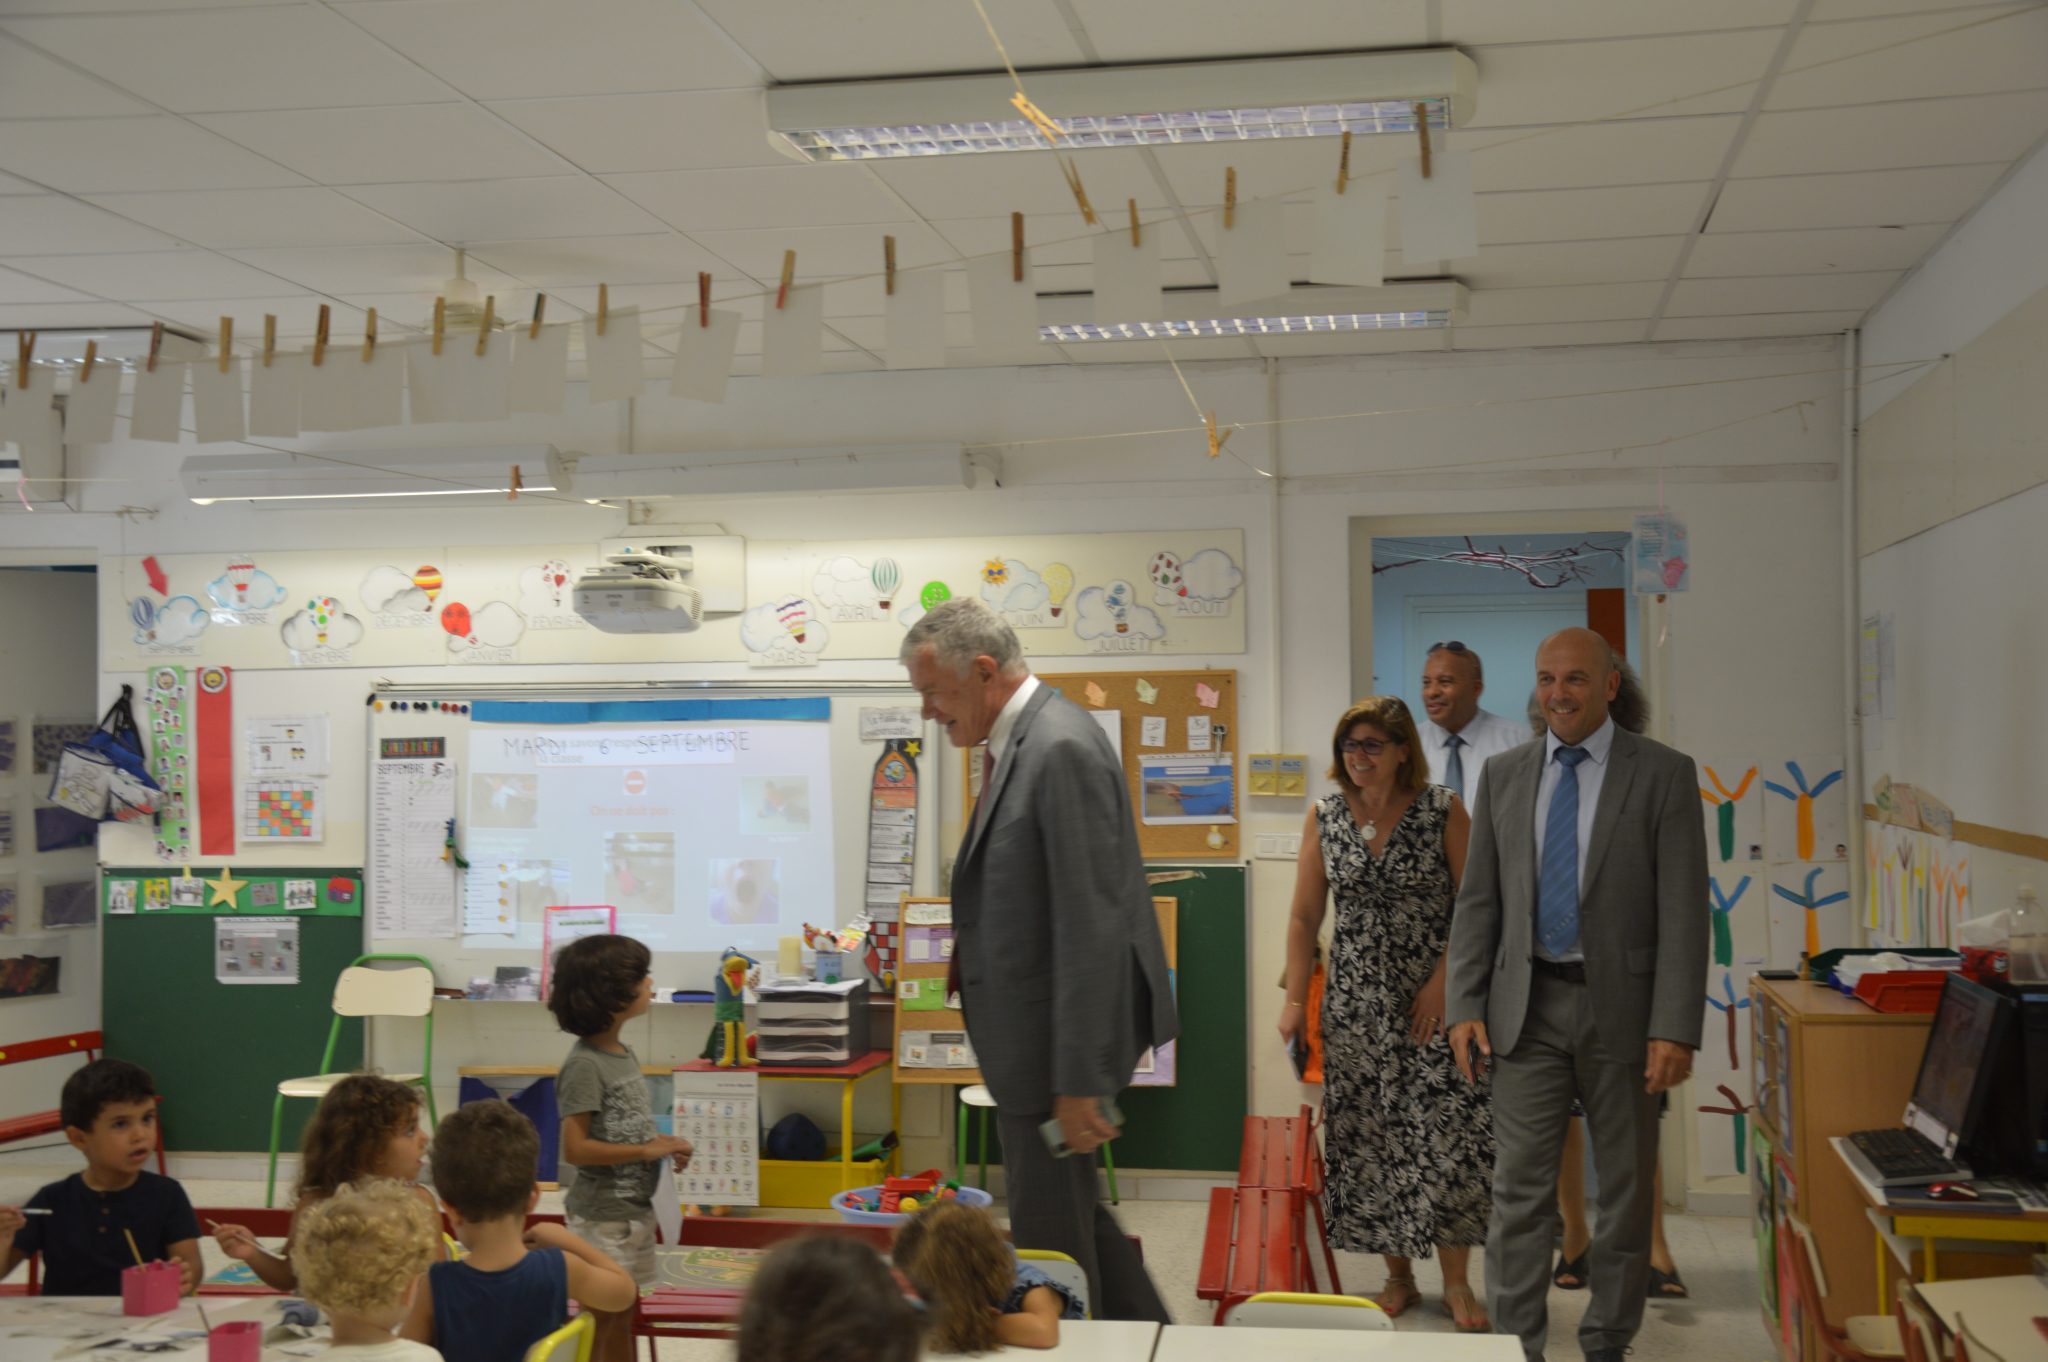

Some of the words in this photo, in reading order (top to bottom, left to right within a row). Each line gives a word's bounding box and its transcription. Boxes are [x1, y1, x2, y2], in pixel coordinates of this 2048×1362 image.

[836, 606, 878, 620] AVRIL
[1092, 637, 1149, 653] JUILLET
[462, 649, 512, 662] JANVIER
[502, 736, 567, 757] MARDI
[599, 738, 610, 755] 6
[637, 731, 752, 754] SEPTEMBRE
[377, 763, 425, 775] SEPTEMBRE
